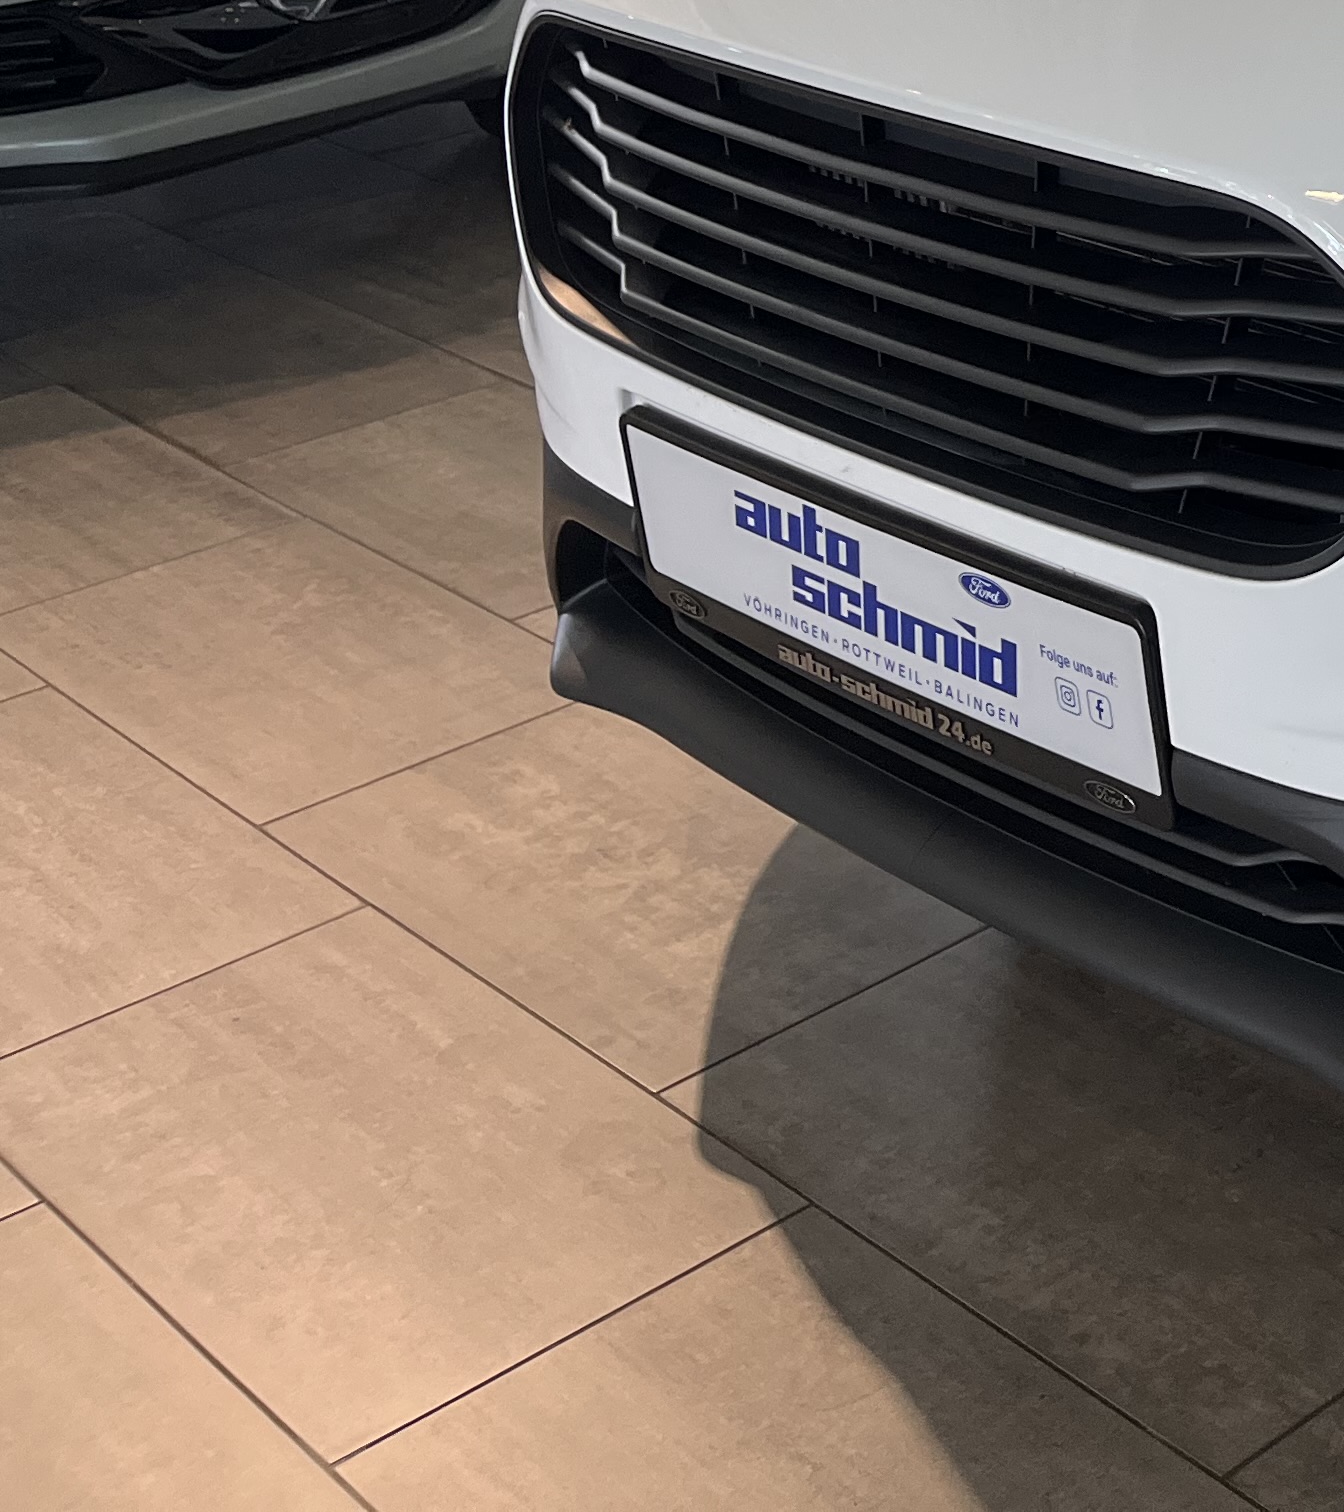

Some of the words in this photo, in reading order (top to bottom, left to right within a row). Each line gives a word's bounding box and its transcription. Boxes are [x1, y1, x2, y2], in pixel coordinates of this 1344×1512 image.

[733, 489, 861, 579] auto
[968, 576, 1001, 605] Ford
[791, 564, 1018, 698] schmid
[1039, 643, 1071, 669] Folge
[1072, 660, 1094, 678] uns
[841, 638, 923, 686] ROTTWEIL
[933, 678, 1019, 728] BALINGEN
[1094, 784, 1125, 809] Ford
